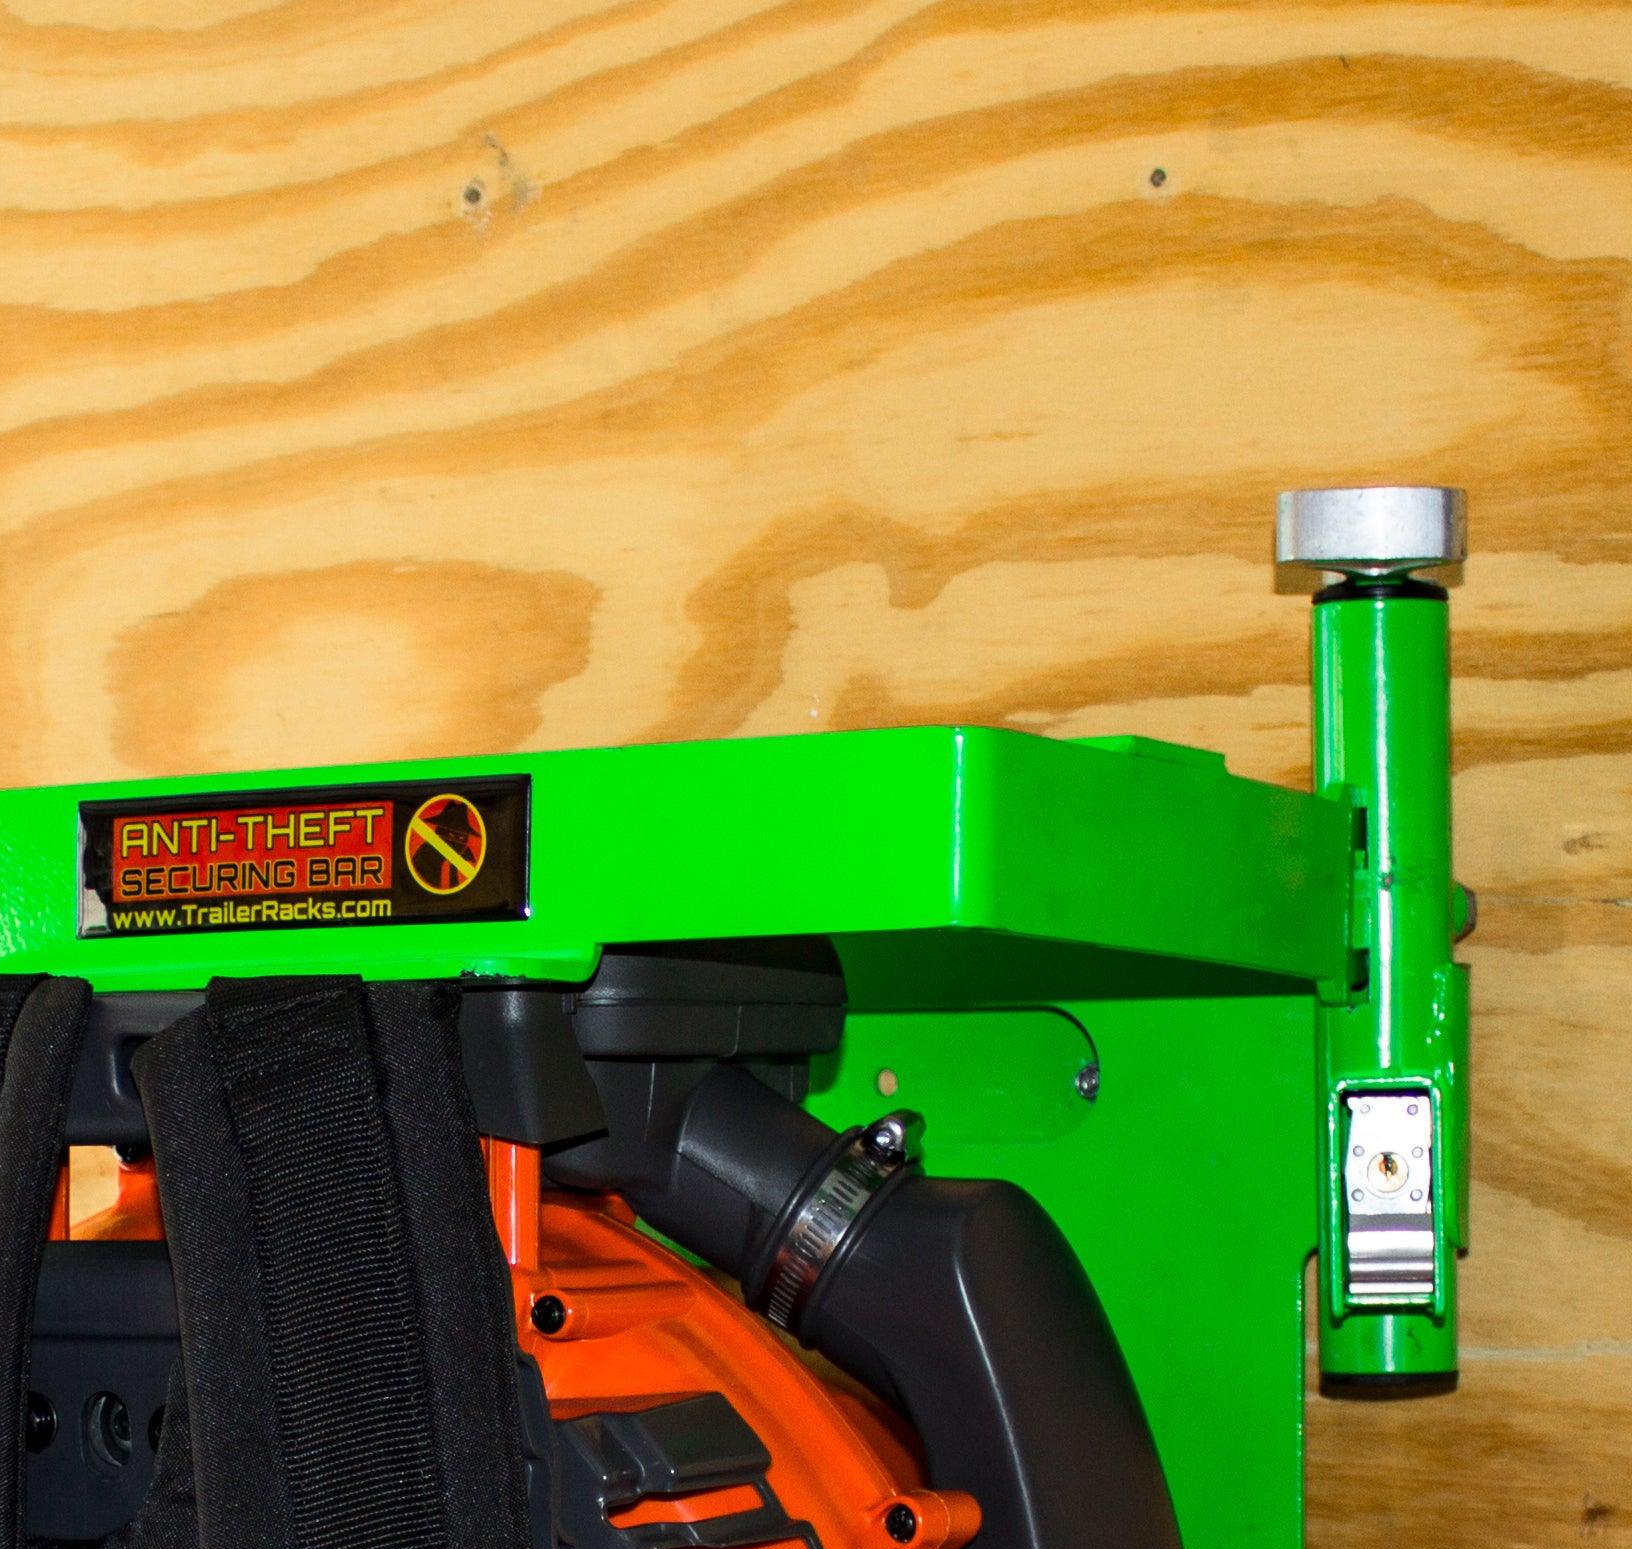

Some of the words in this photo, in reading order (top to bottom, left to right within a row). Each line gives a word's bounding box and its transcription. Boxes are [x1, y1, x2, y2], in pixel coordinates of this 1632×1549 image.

[120, 807, 385, 859] ANTI-THEFT
[120, 859, 297, 898] SECURING
[306, 855, 384, 888] BAR
[112, 897, 392, 930] www.TrailerRacks.com
